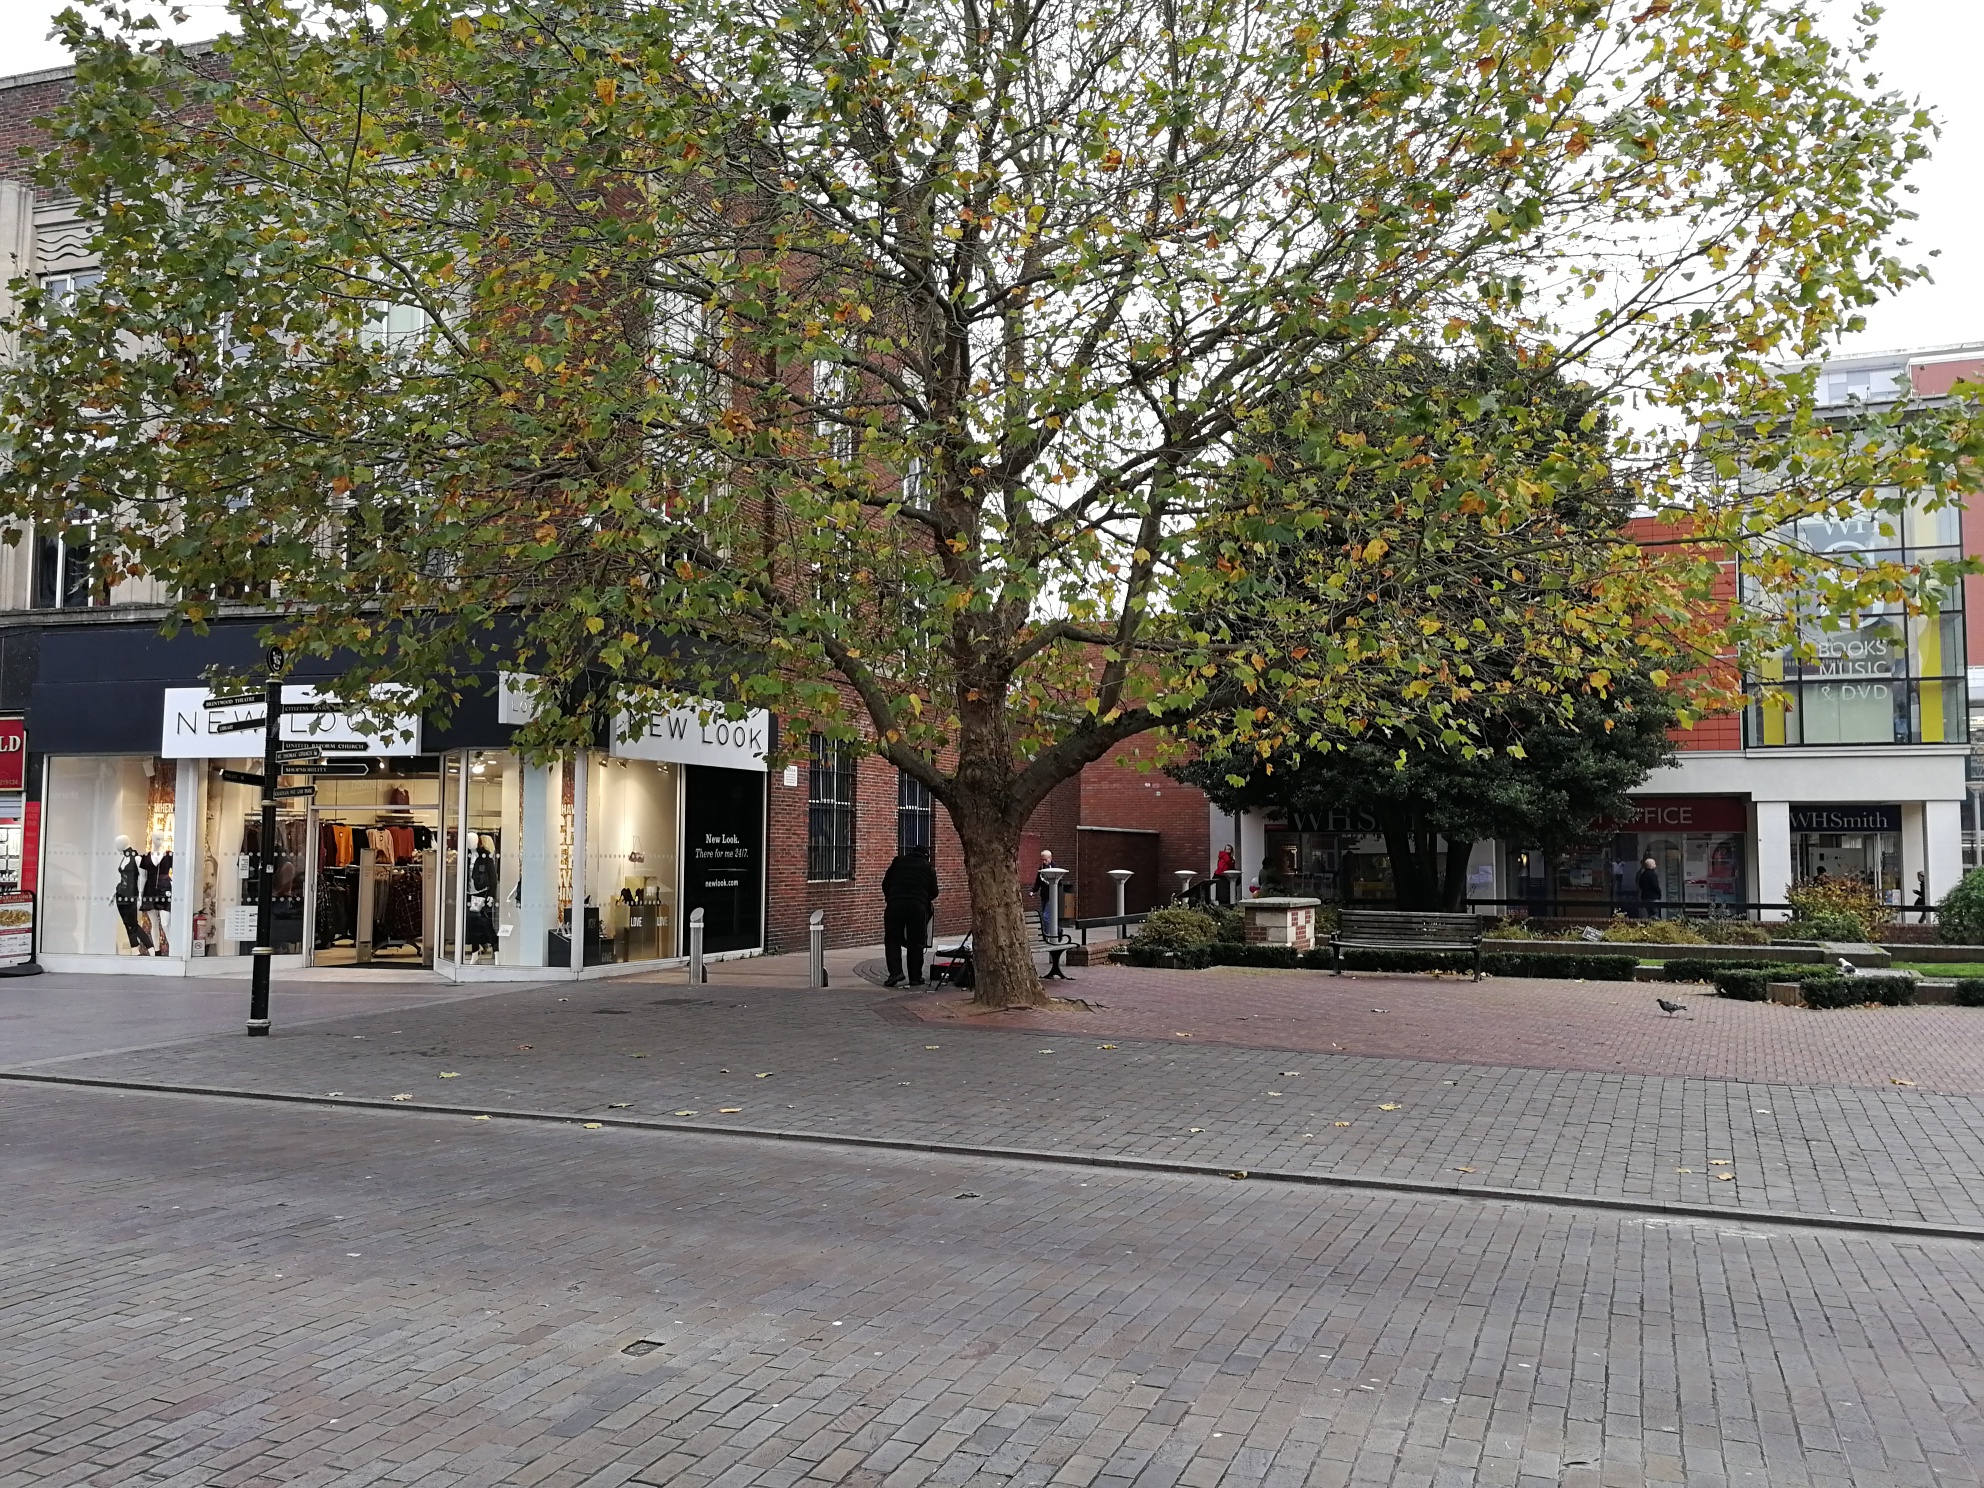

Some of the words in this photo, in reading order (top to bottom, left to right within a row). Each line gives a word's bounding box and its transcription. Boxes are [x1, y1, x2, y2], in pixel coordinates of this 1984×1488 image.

[1818, 640, 1887, 657] BOOKS
[1818, 660, 1888, 677] MUSIC
[1821, 685, 1836, 700] &
[1841, 684, 1888, 700] DVD
[204, 698, 234, 707] BRENTWOOD
[235, 696, 255, 704] THEATRE
[702, 723, 762, 750] LOOK
[154, 803, 174, 812] WHEN
[1790, 811, 1888, 828] WHSmith
[705, 833, 721, 843] New
[722, 833, 740, 843] Look.
[695, 848, 714, 858] There
[714, 848, 724, 858] for
[725, 850, 734, 858] me
[705, 878, 739, 887] newlook.com
[646, 886, 655, 896] JOY
[630, 916, 643, 927] LOVE
[656, 916, 669, 927] LOVE
